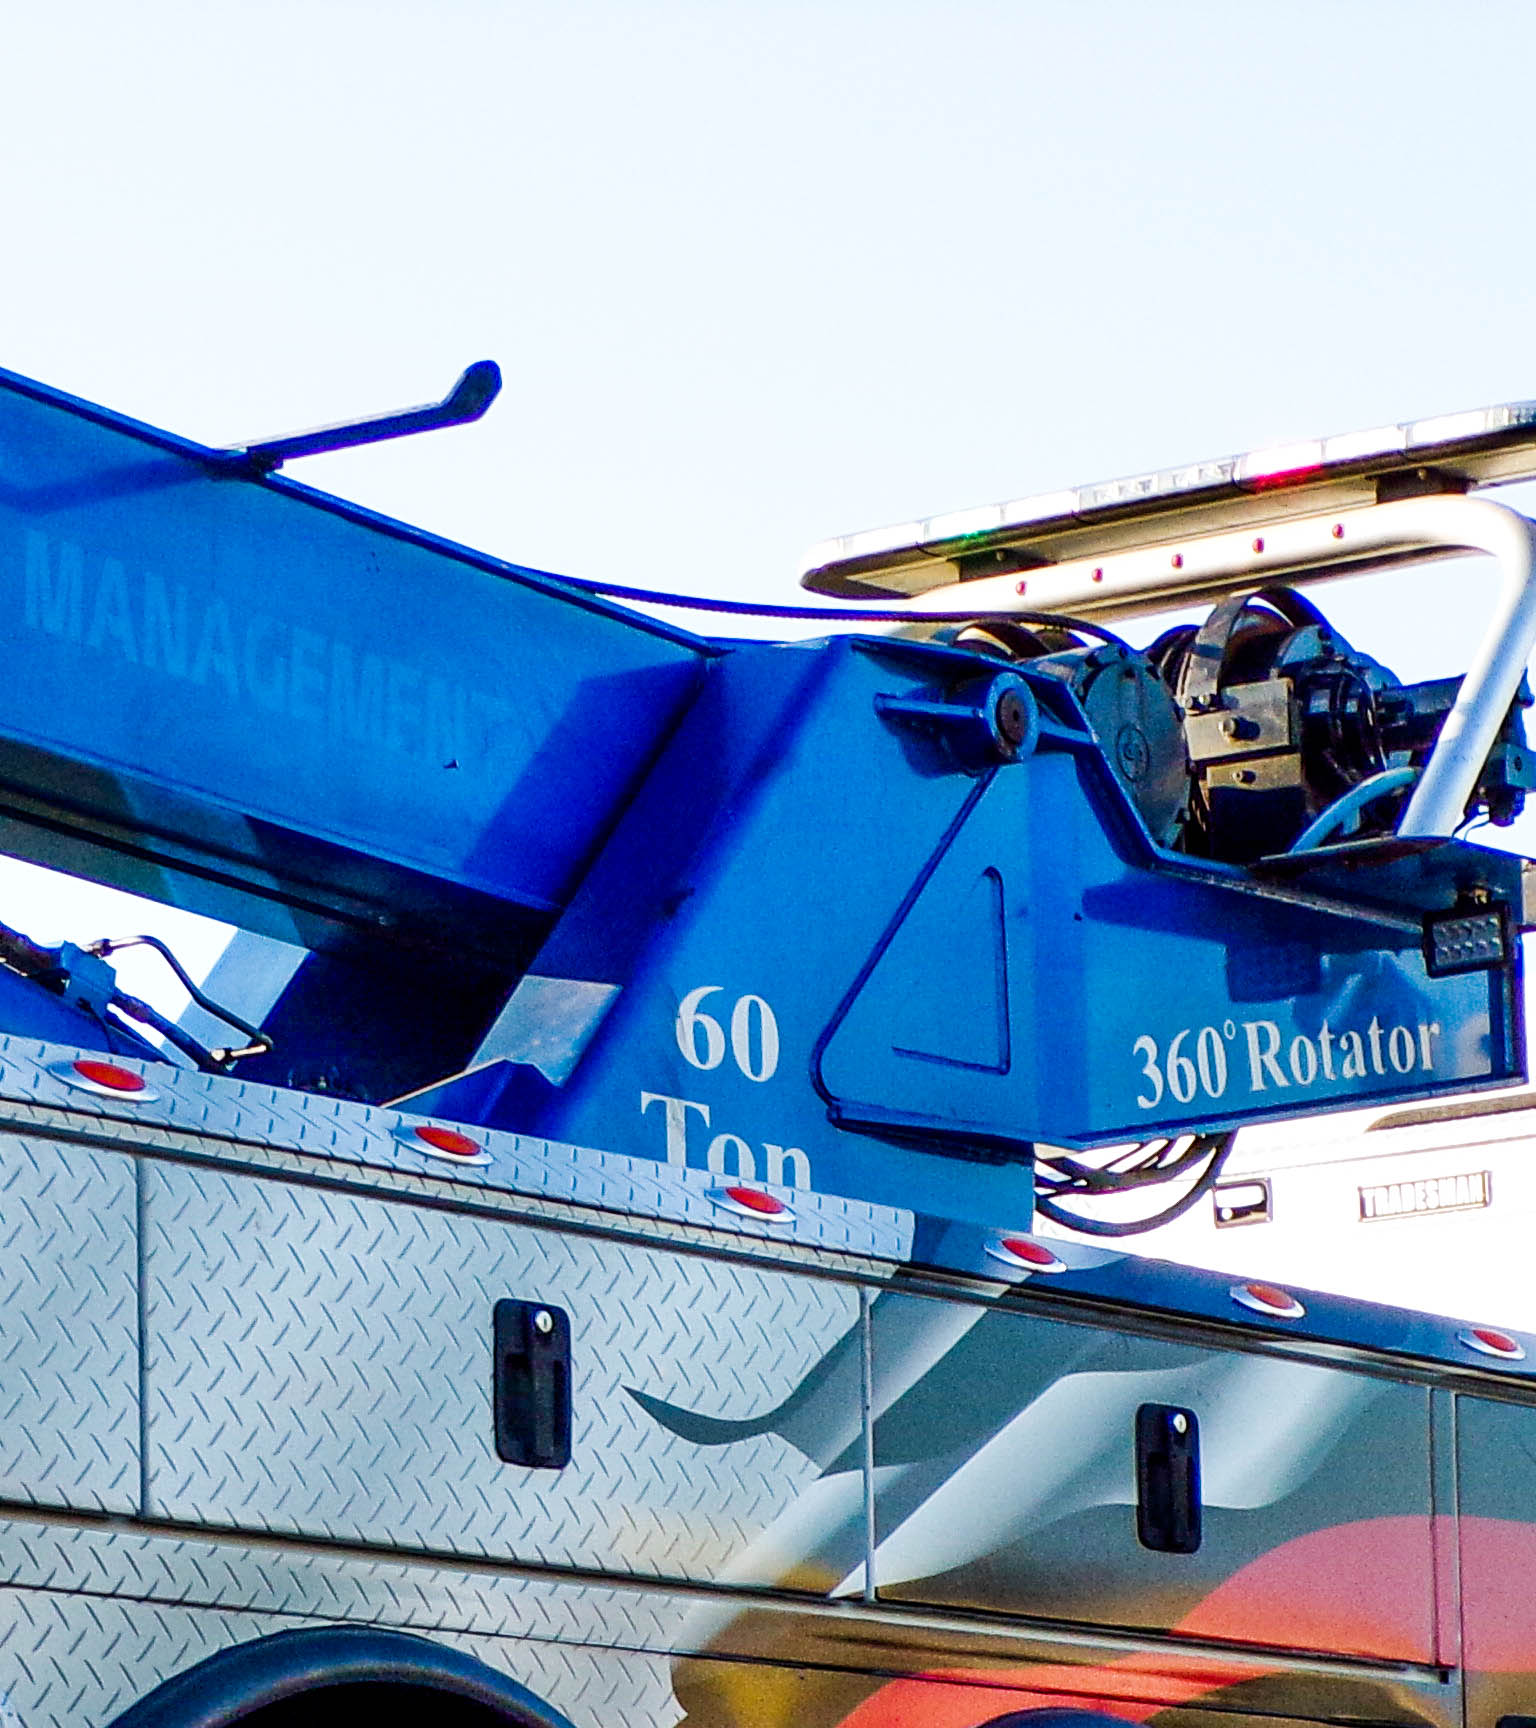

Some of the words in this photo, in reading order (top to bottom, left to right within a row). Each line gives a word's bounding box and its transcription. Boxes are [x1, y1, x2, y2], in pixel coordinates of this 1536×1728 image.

[24, 527, 516, 780] MANAGEMENT
[675, 985, 780, 1083] 60
[1241, 1014, 1441, 1092] Rotator
[640, 1090, 812, 1192] Ton
